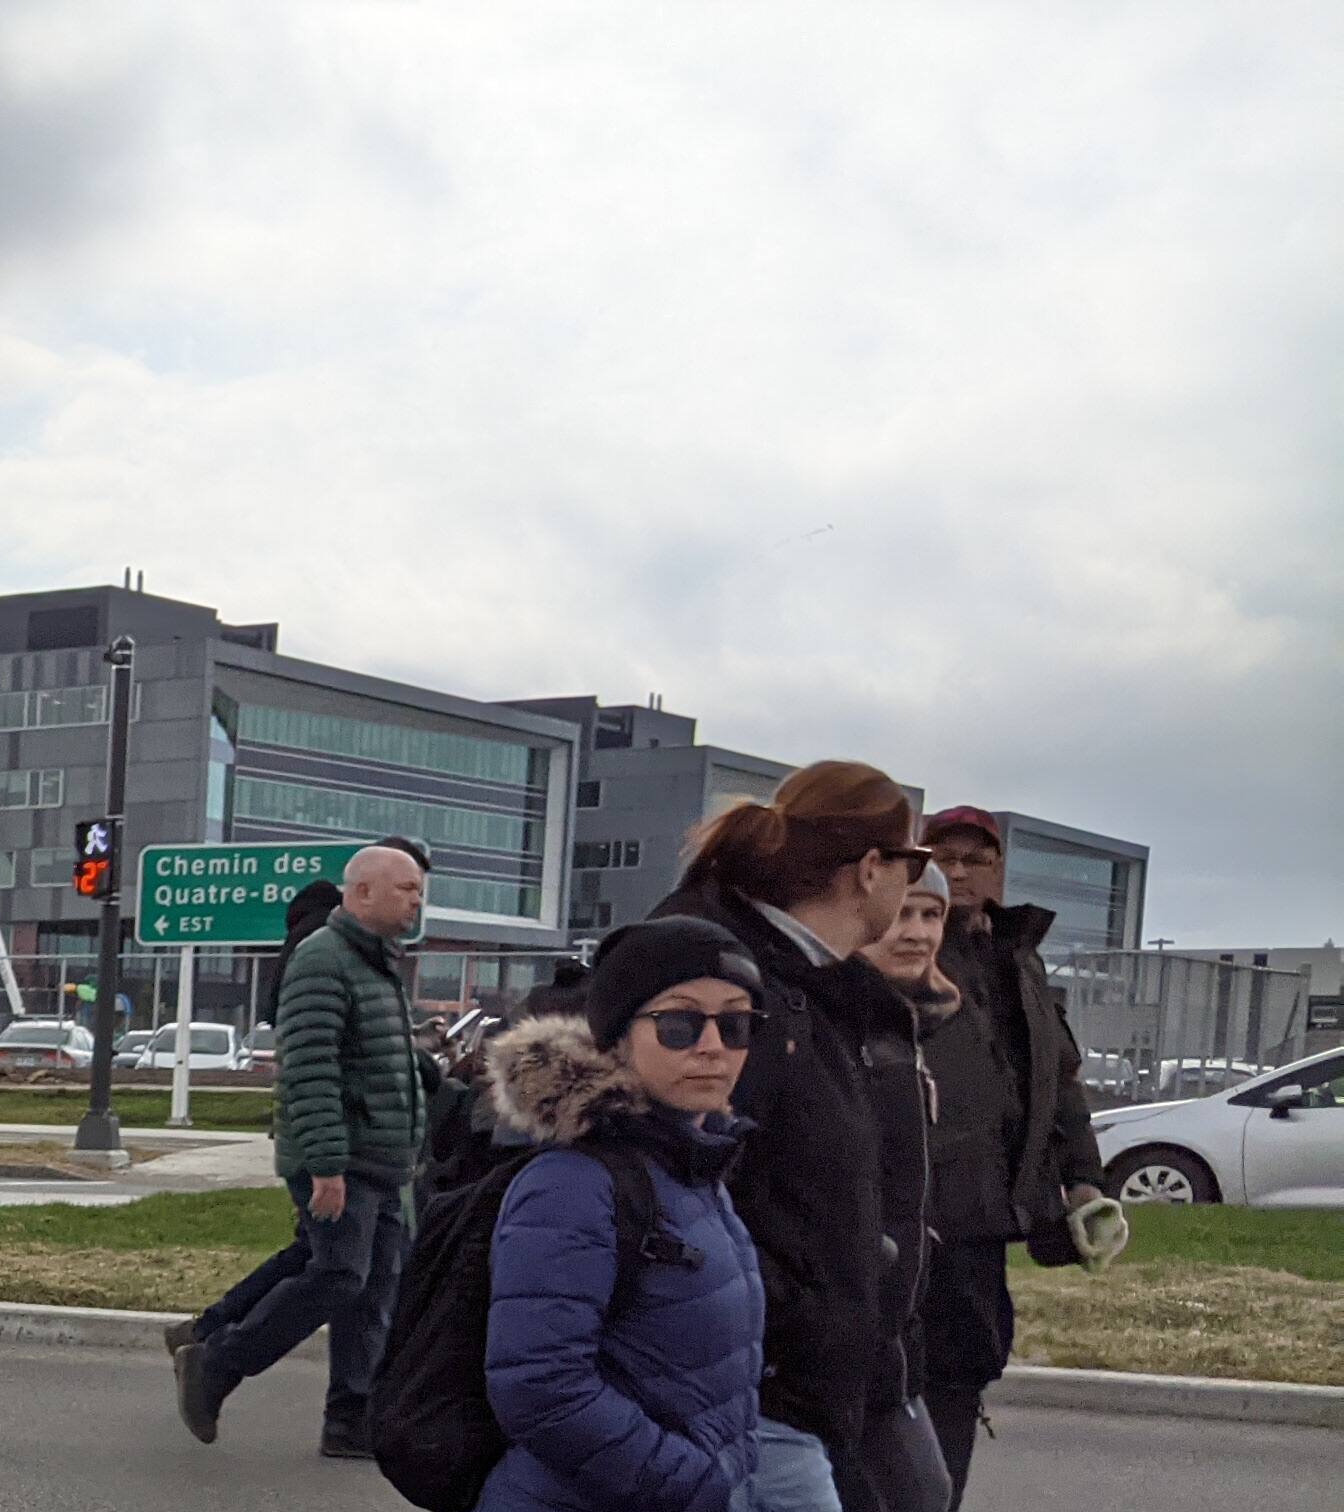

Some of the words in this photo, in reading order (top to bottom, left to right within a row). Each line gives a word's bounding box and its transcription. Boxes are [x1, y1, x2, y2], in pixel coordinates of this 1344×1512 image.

[155, 853, 258, 876] Chemin
[274, 853, 322, 874] des
[155, 884, 297, 906] Quatre-Bo
[179, 916, 213, 932] EST
